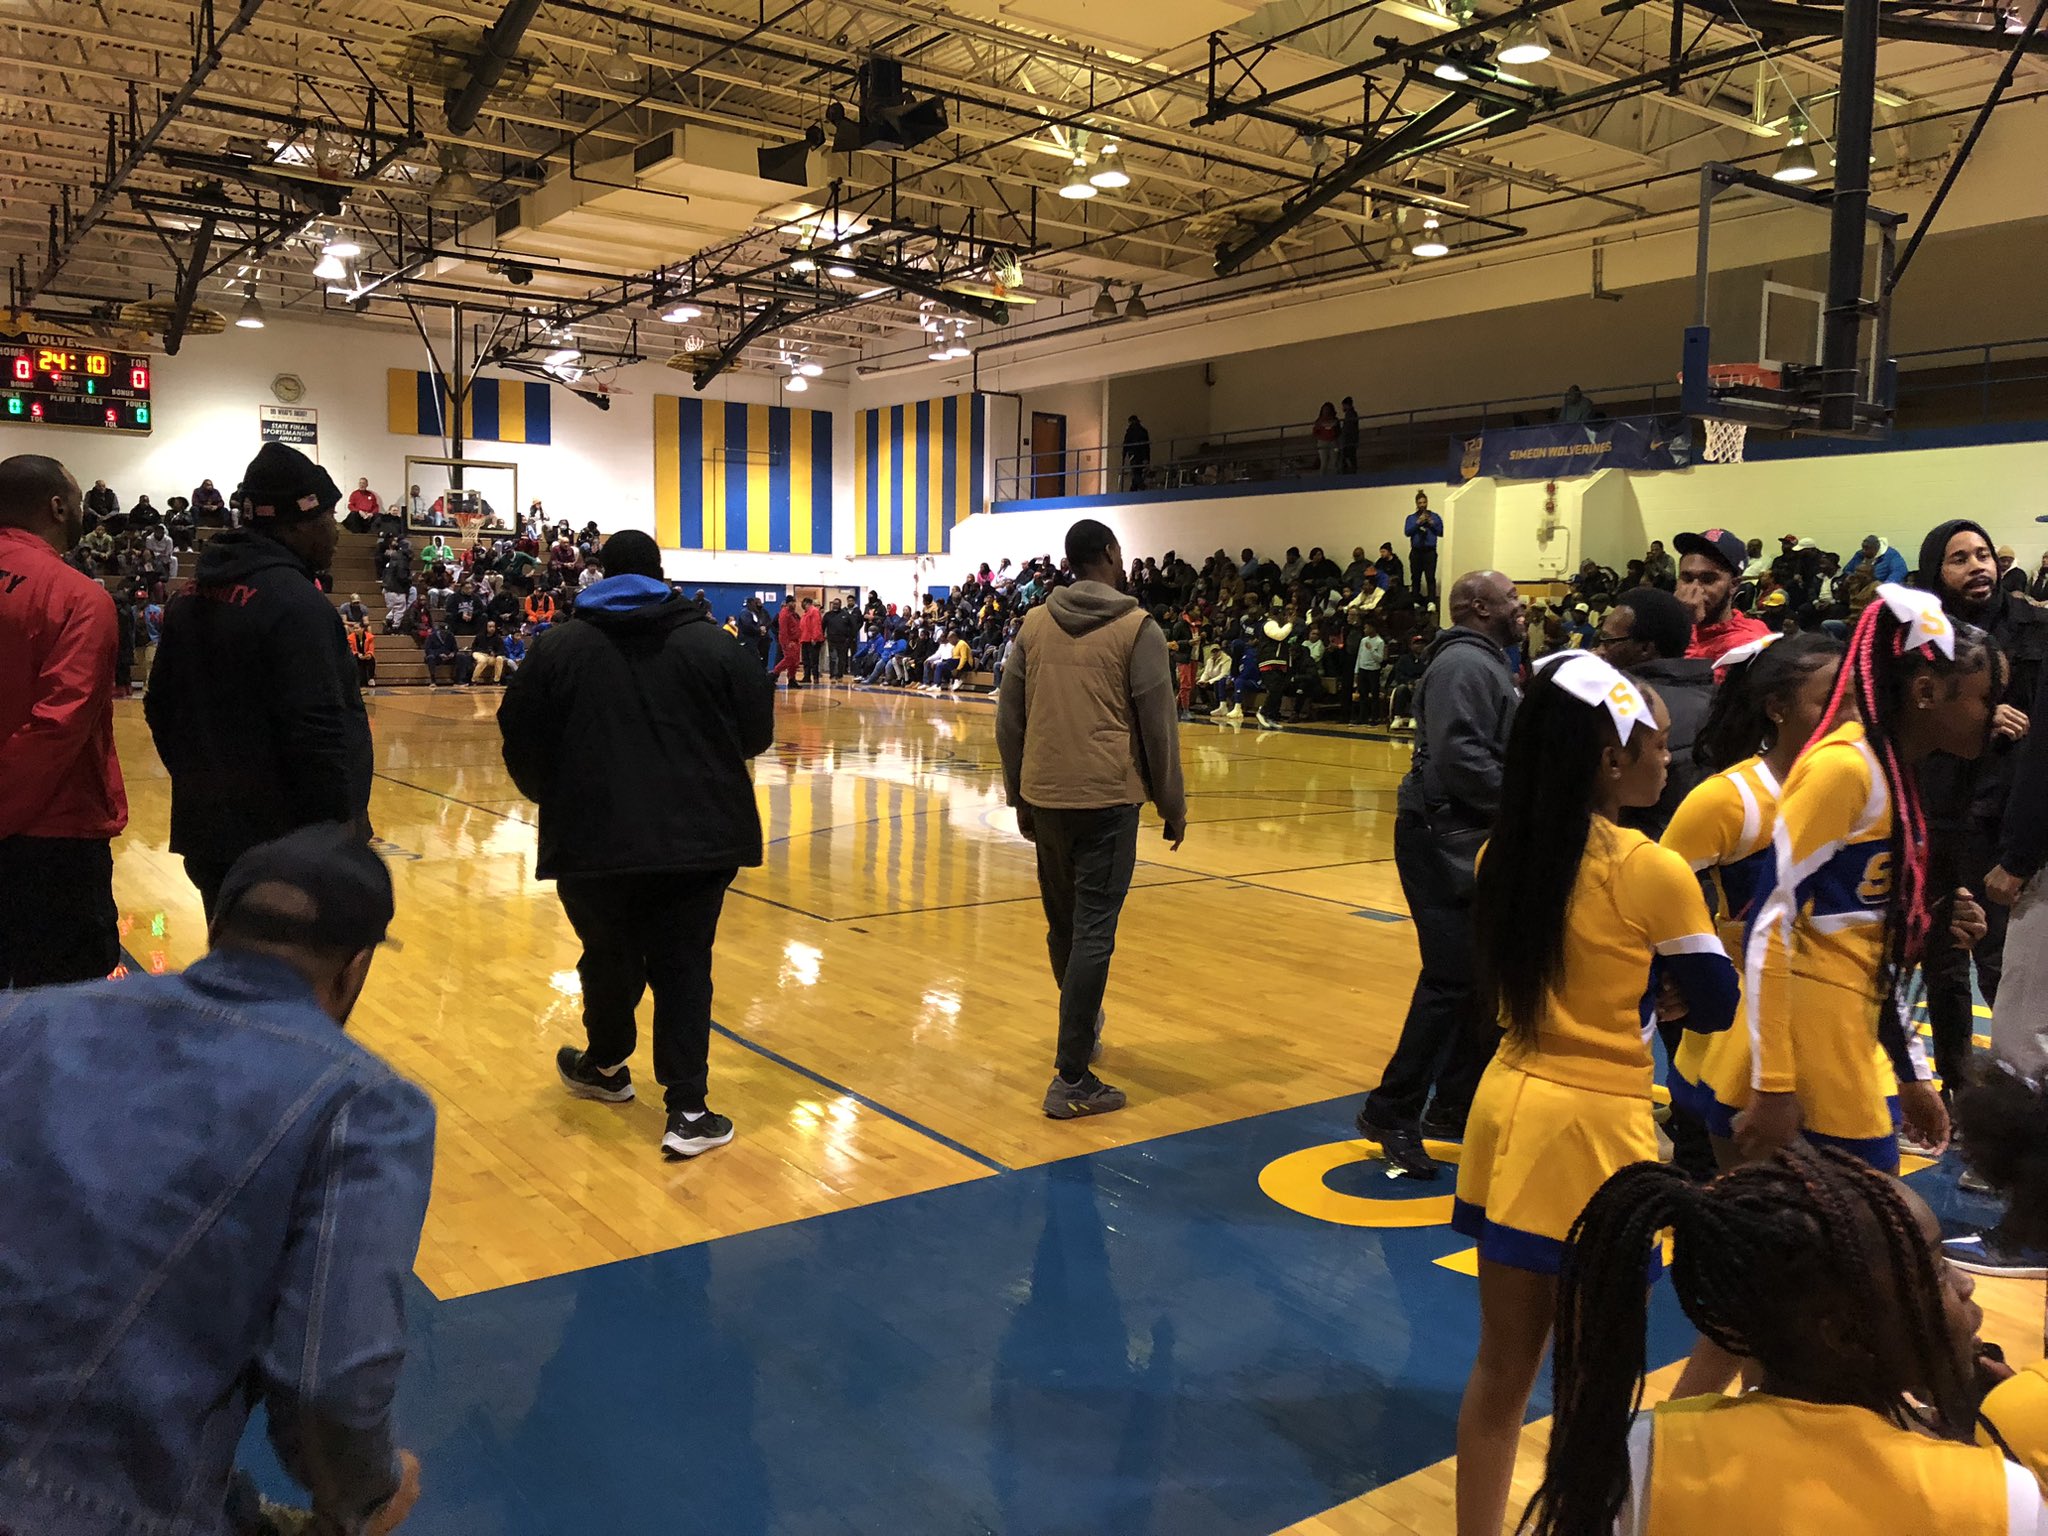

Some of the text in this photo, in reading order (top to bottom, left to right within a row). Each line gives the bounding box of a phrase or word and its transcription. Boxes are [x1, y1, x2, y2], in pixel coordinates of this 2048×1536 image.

[16, 360, 30, 378] 0
[39, 350, 106, 374] 24:10
[87, 379, 94, 394] 1
[132, 370, 146, 388] 0
[50, 394, 103, 405] PLAYER FOULS
[111, 388, 135, 397] BONUS
[8, 398, 21, 414] 0
[125, 401, 147, 409] FOULS
[136, 408, 148, 423] 0
[263, 428, 315, 437] SPORTSMANSHIP
[1508, 440, 1612, 460] SIMEON WOLVERINES
[1919, 610, 1946, 636] S
[1608, 682, 1639, 716] S
